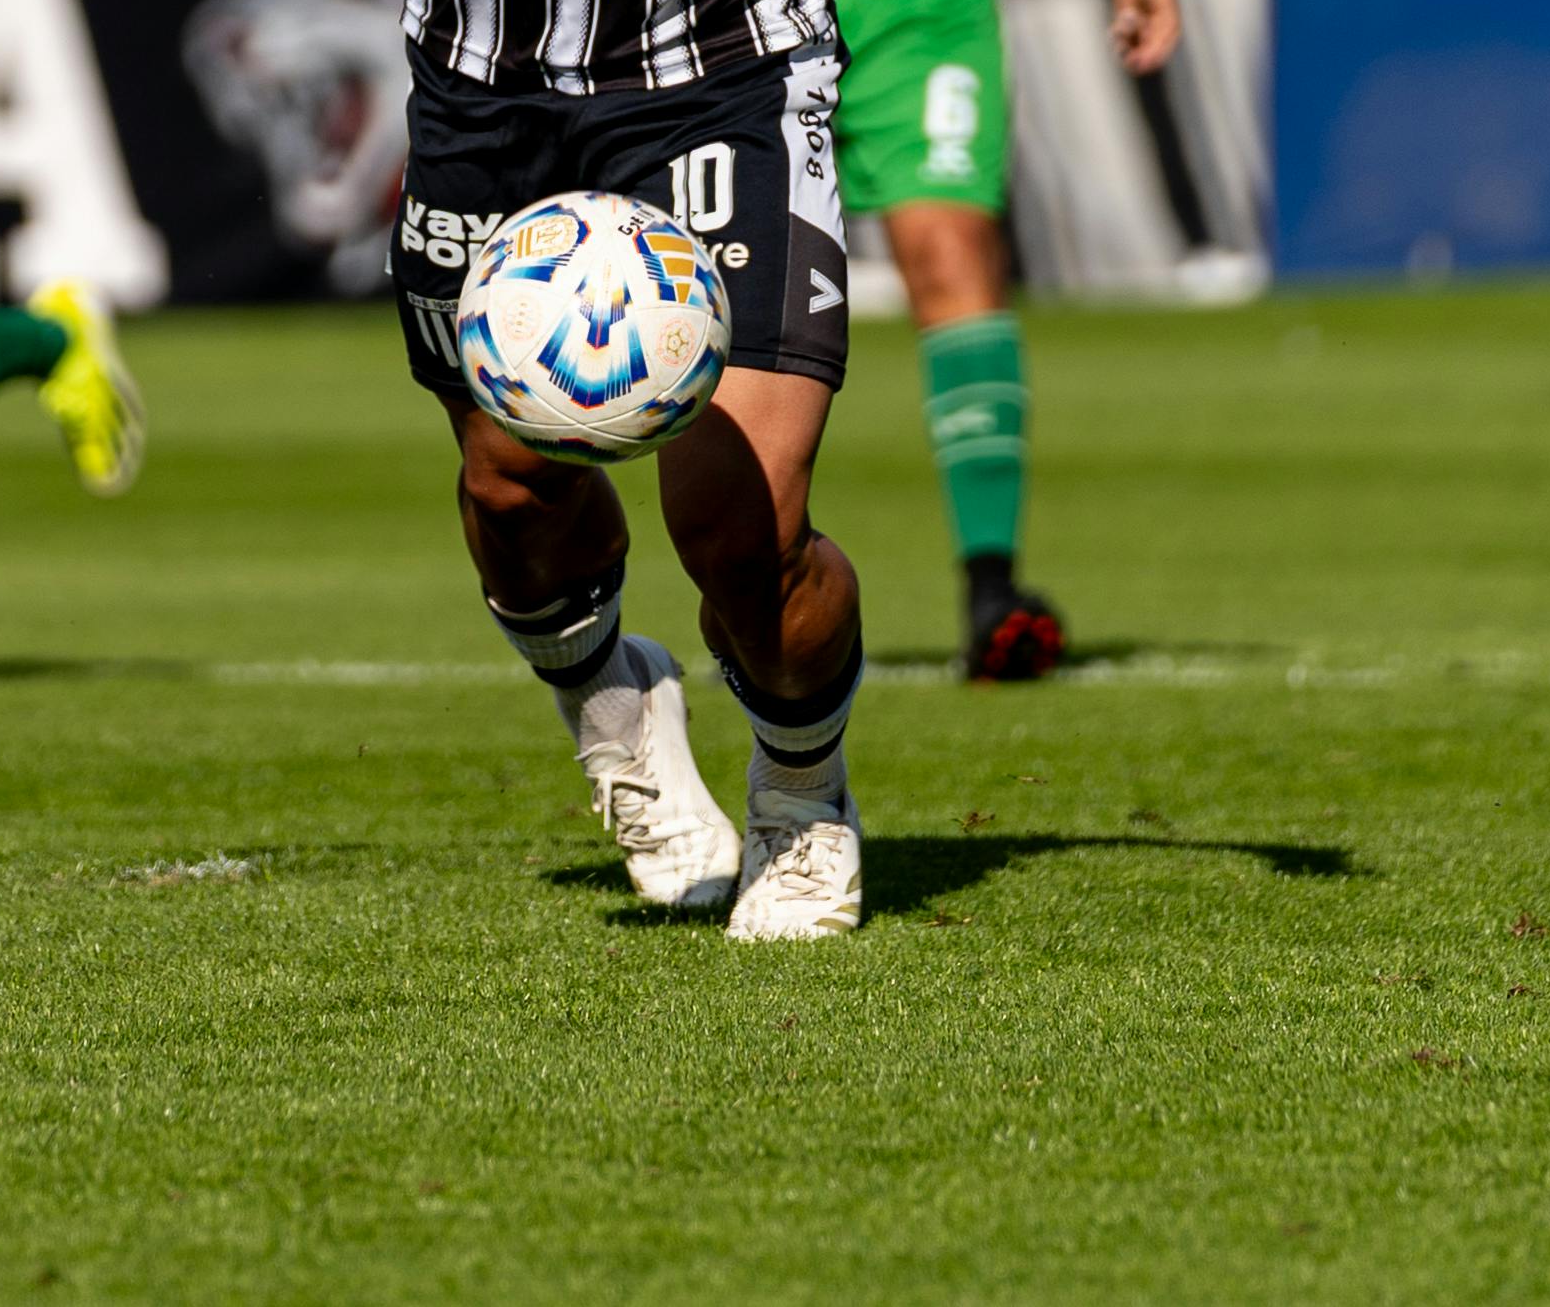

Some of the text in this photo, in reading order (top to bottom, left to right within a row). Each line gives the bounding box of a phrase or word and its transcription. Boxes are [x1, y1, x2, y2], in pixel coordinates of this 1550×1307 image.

[798, 86, 827, 180] 1908
[923, 64, 981, 138] 6
[668, 141, 736, 232] 10
